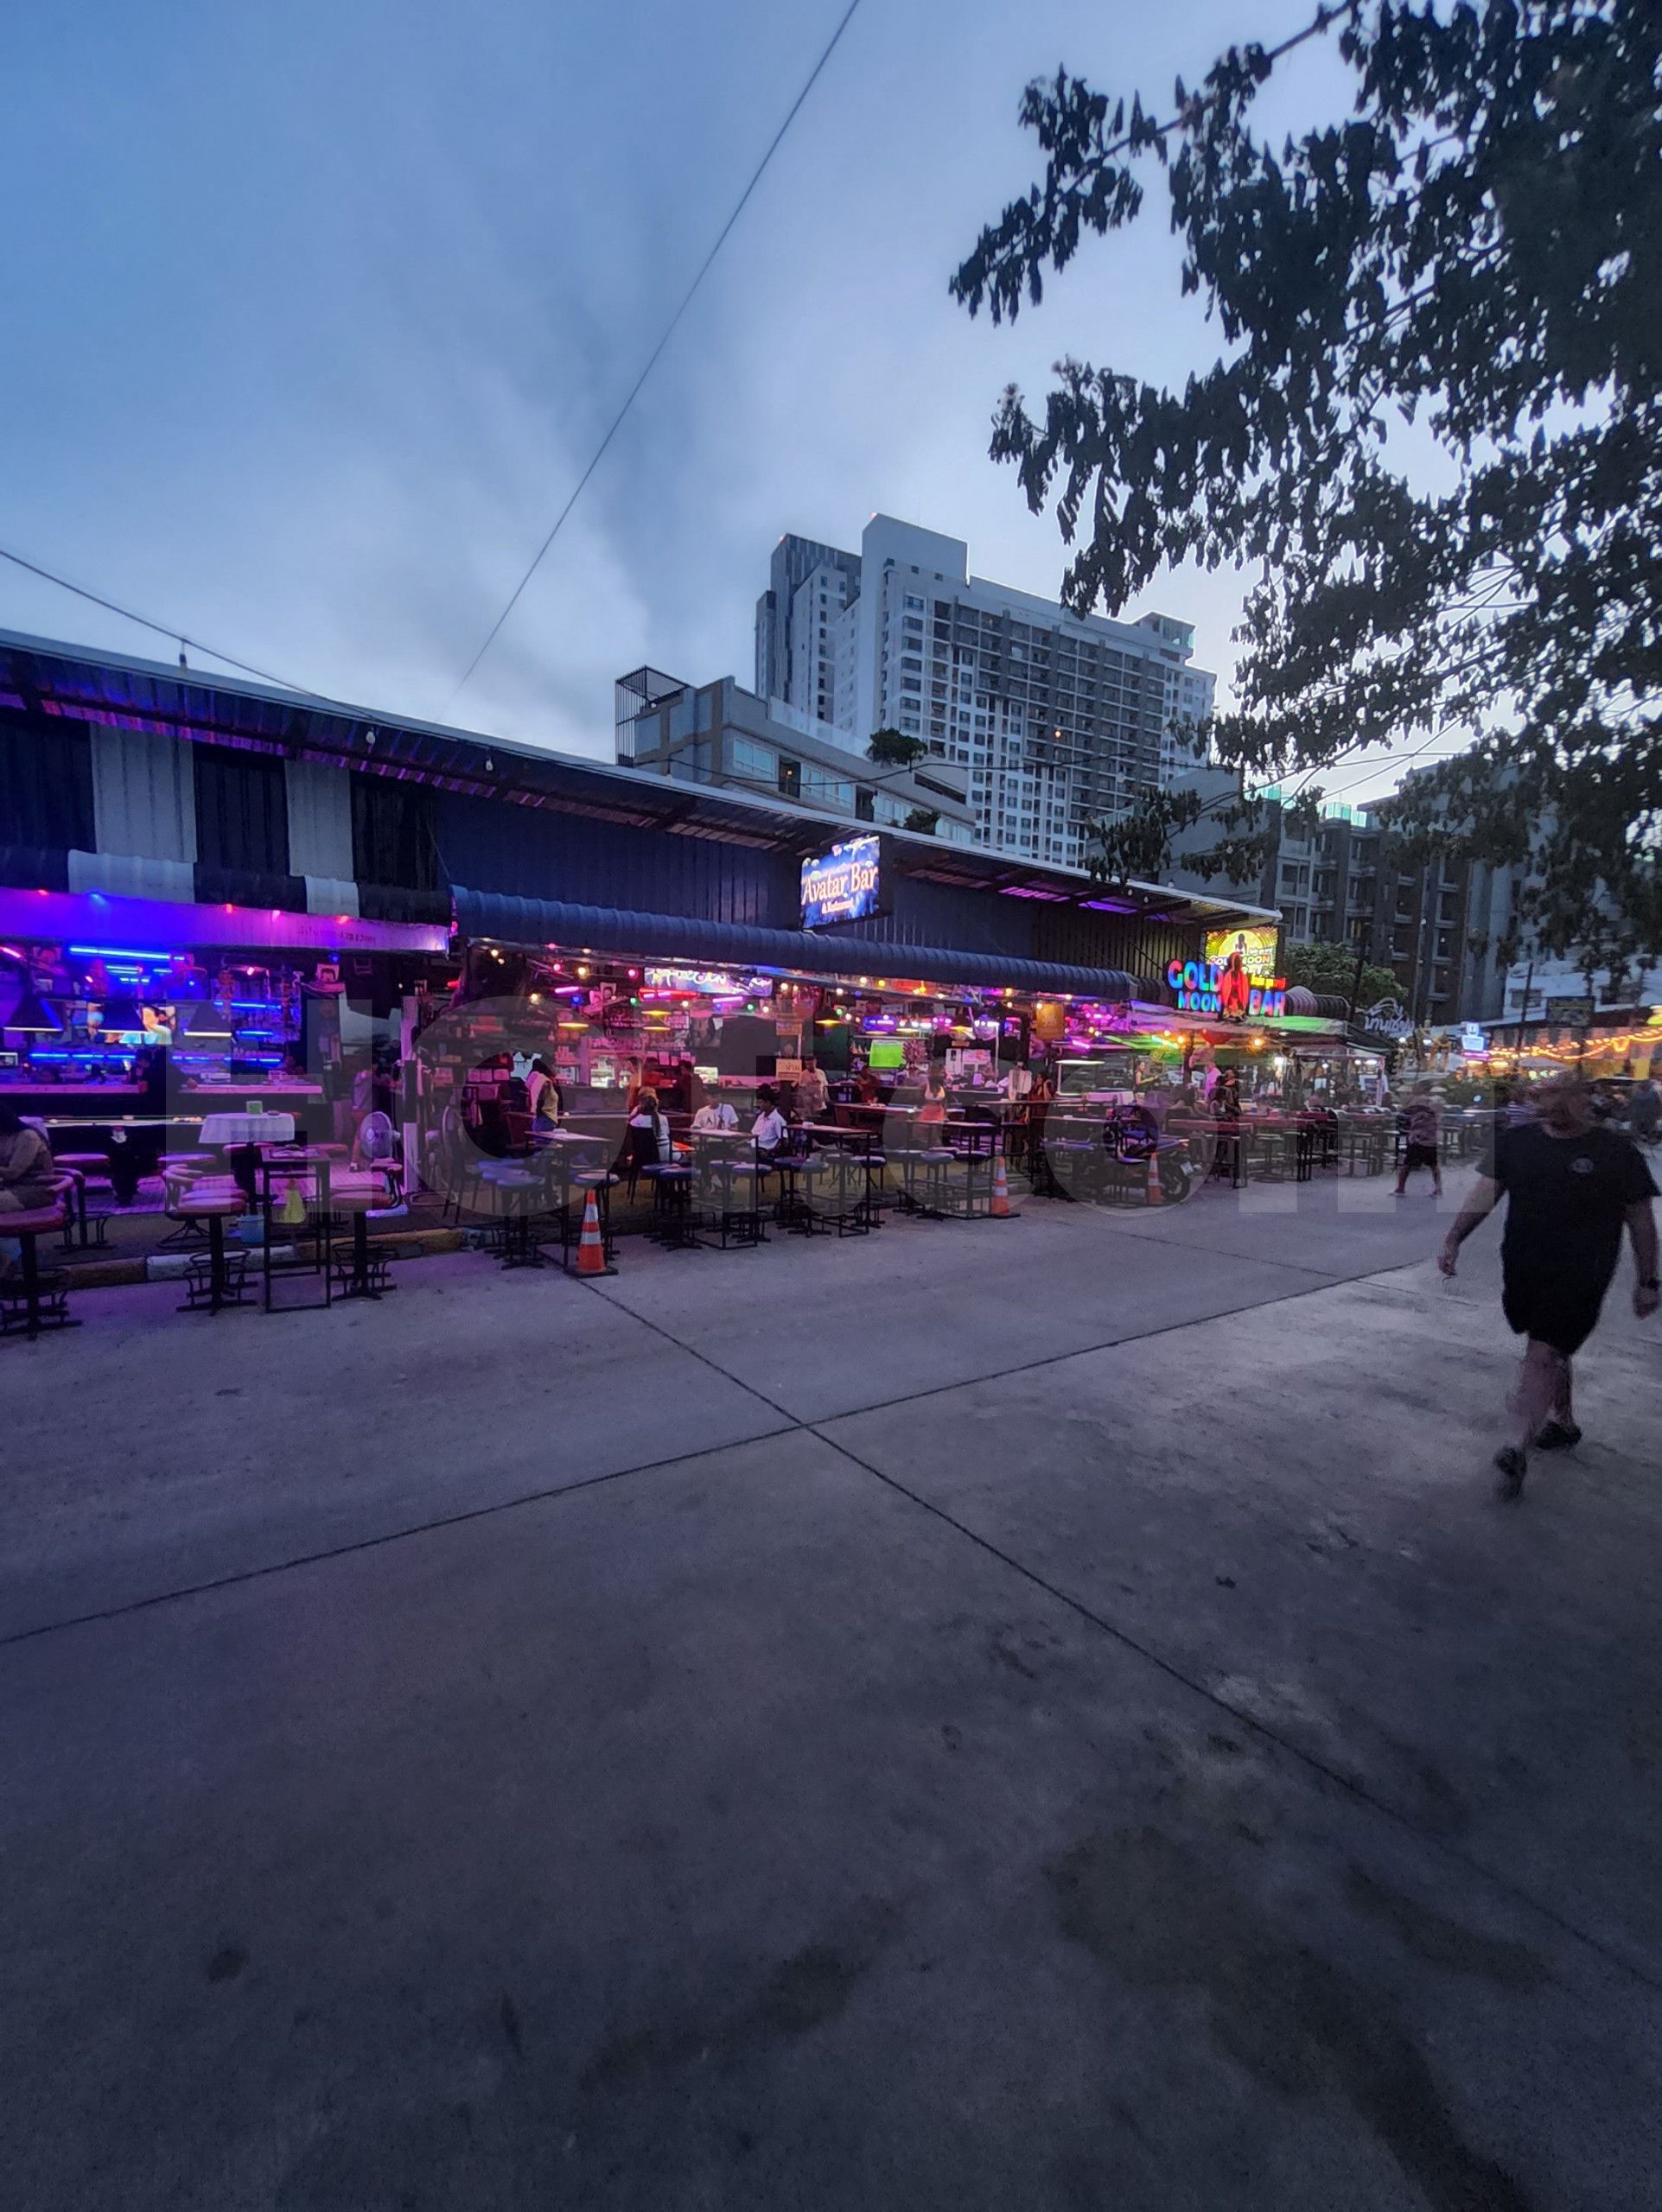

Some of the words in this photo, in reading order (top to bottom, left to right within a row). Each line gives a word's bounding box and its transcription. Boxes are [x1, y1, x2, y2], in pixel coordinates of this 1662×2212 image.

[801, 873, 849, 906] Avatar
[850, 862, 879, 893] Bar
[1167, 959, 1224, 992] GOLD
[1177, 990, 1222, 1012] MOON
[1248, 988, 1286, 1017] BAR
